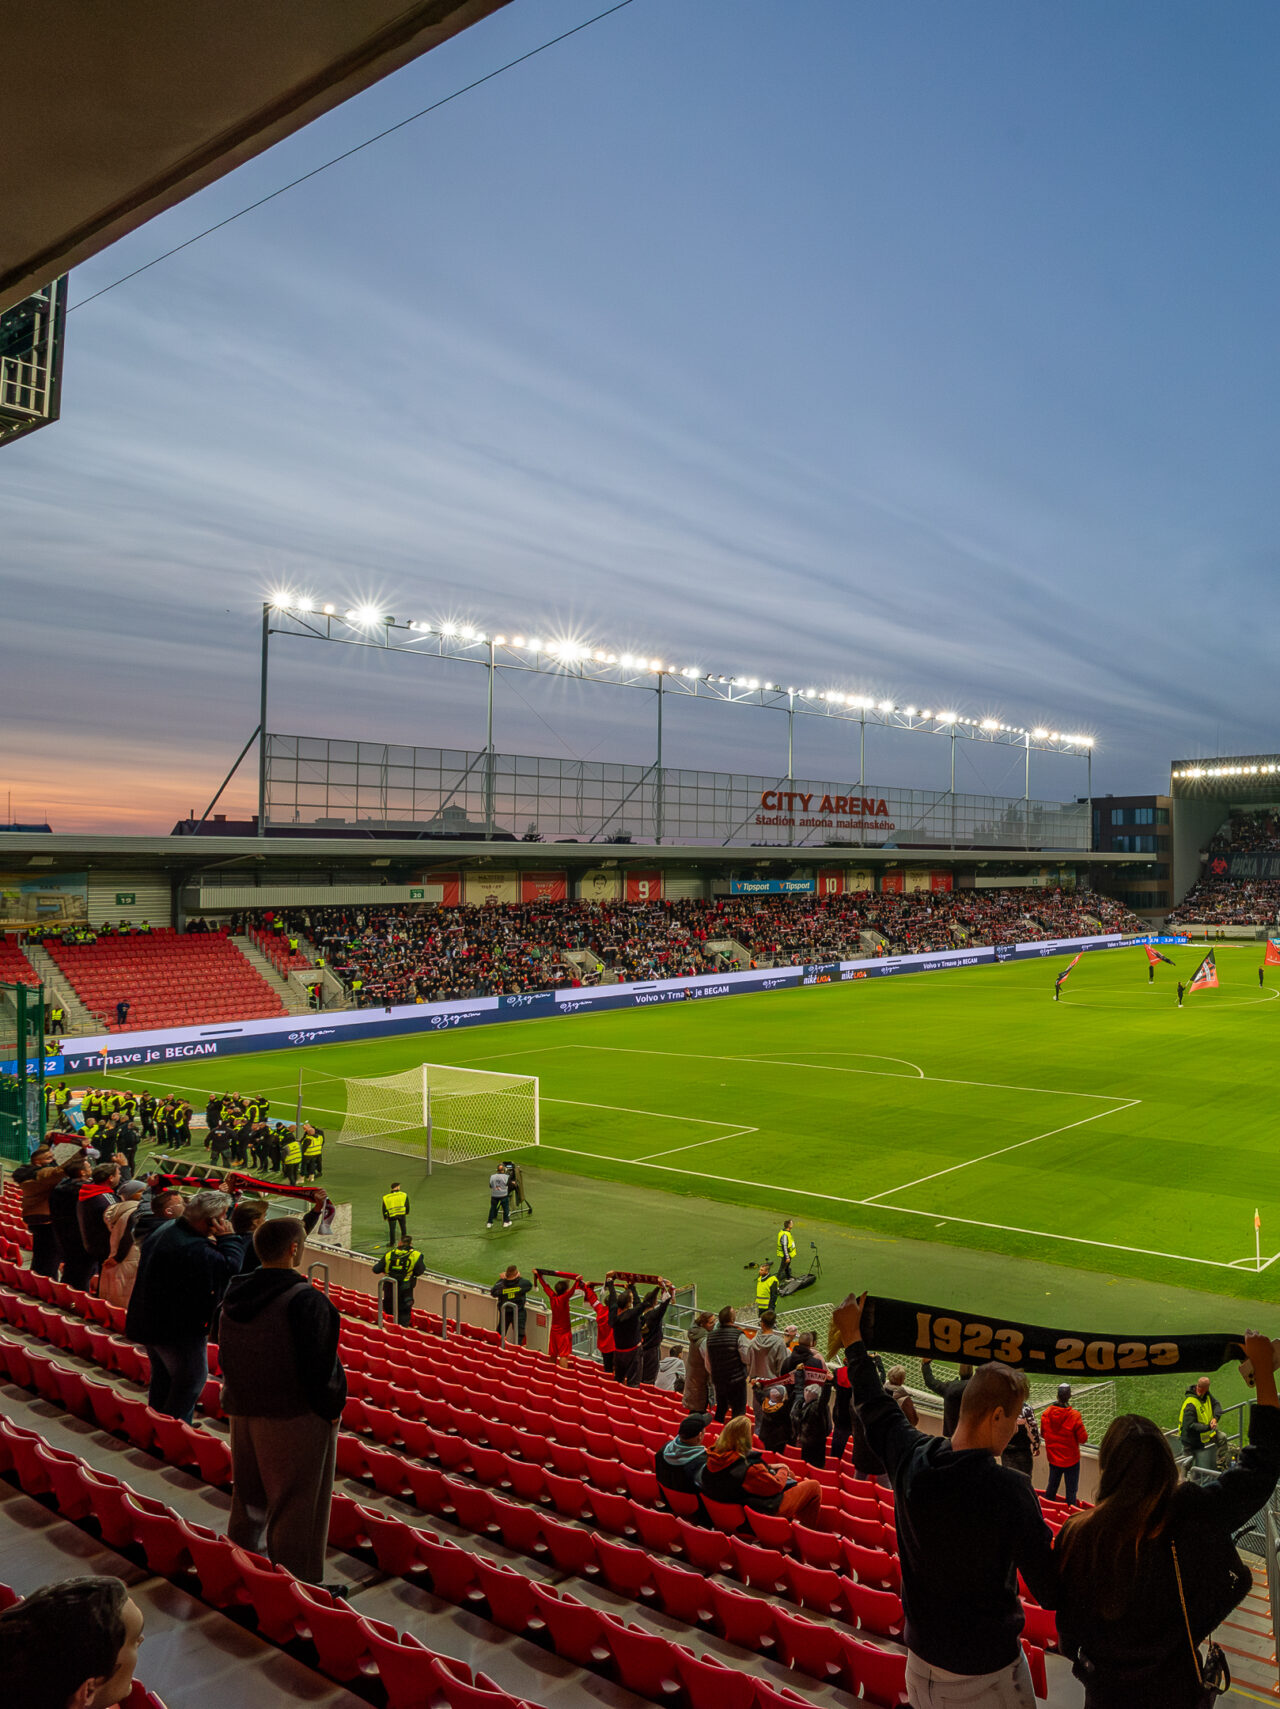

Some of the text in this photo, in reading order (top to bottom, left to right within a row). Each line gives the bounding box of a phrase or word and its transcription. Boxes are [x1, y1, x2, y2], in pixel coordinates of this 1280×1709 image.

[761, 790, 889, 817] CITY ARENA
[755, 813, 795, 827] štadión
[800, 817, 833, 828] antona
[638, 880, 649, 899] 9
[743, 883, 770, 892] Tipsport
[785, 882, 810, 891] Tipsport
[825, 878, 837, 893] 10
[923, 962, 937, 970] Volvo
[962, 957, 978, 965] BEGAM
[635, 994, 658, 1003] Volvo
[667, 991, 694, 1000] Trna
[695, 990, 703, 998] je
[704, 986, 730, 995] BEGAM
[70, 1042, 217, 1069] v Trnave je BEGAM
